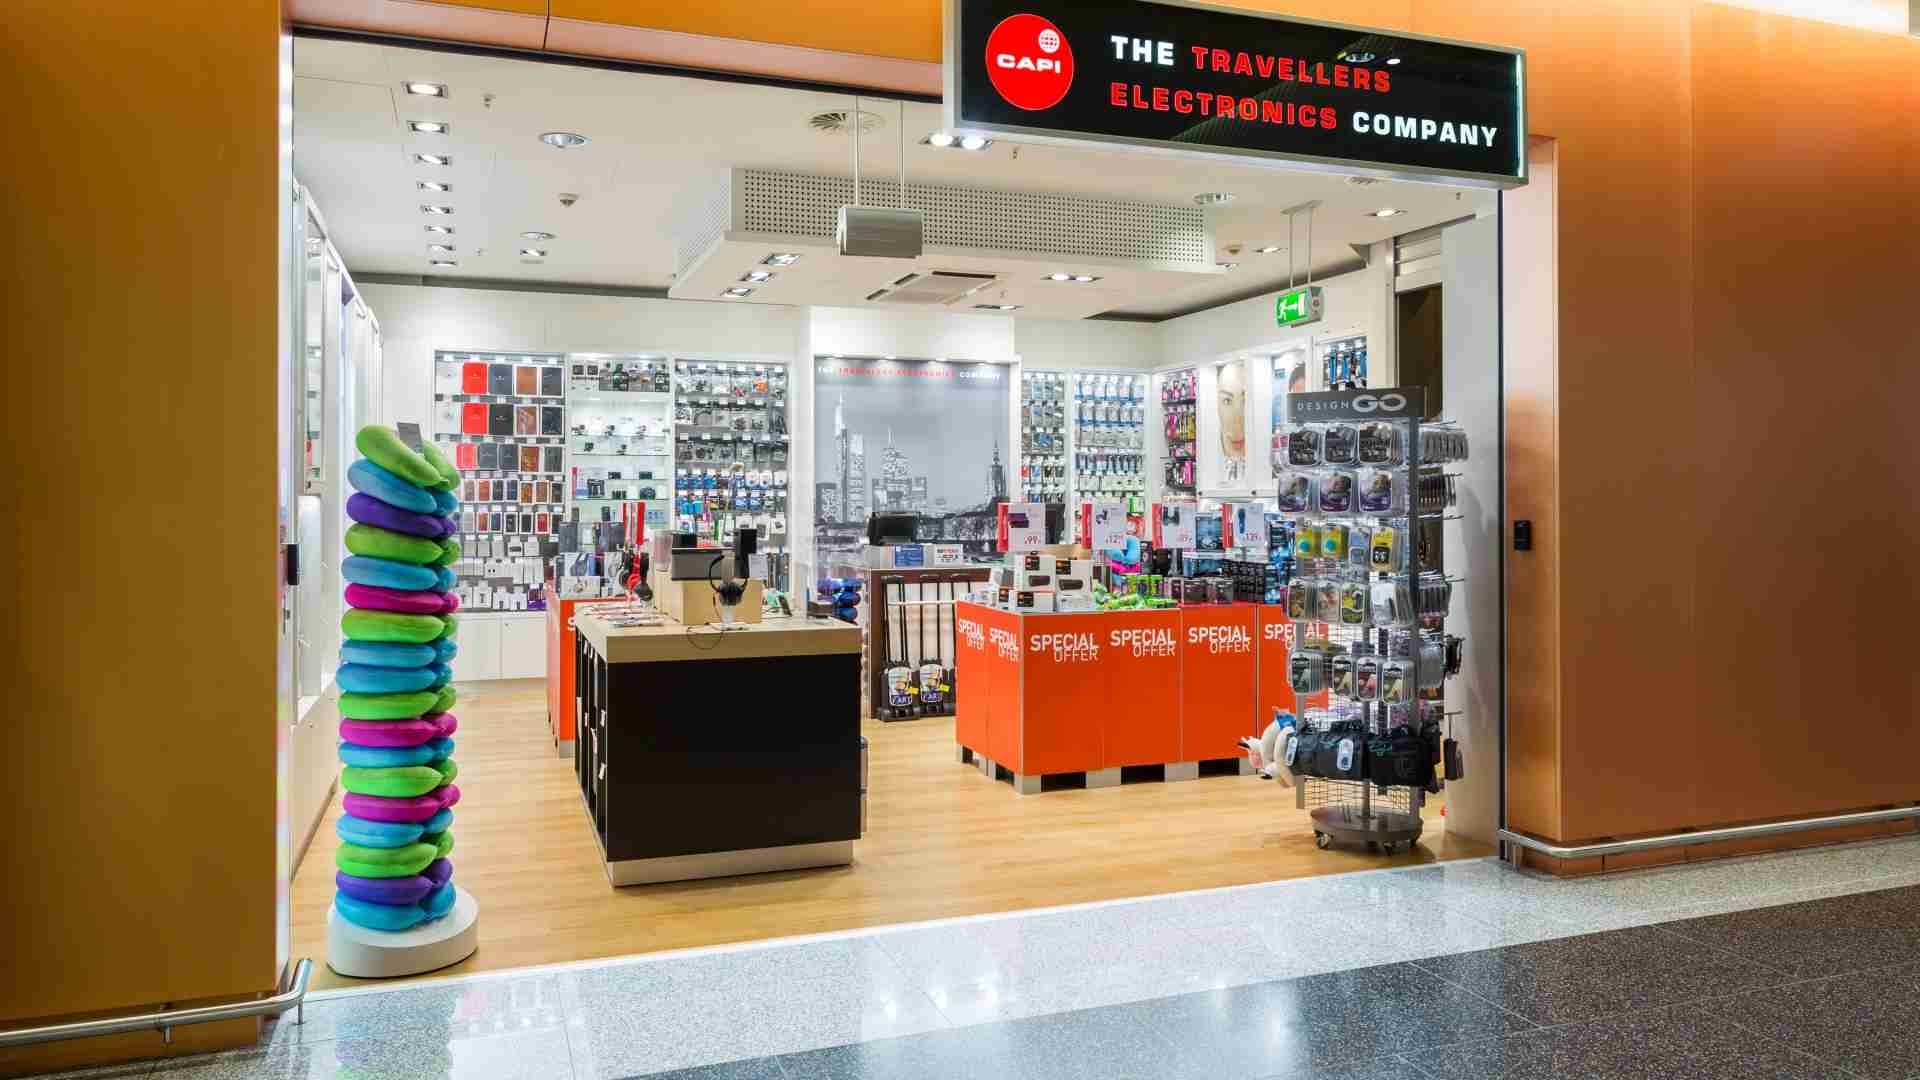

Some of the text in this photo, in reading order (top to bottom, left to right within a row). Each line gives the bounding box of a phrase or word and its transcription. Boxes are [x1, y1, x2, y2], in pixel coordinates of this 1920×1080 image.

[996, 53, 1062, 74] CAPI
[1110, 35, 1391, 93] THE TRAVELLERS
[1110, 82, 1497, 147] ELECTRONICS COMPANY
[1297, 393, 1407, 412] DESIGN GO
[959, 618, 985, 640] SPECIAL
[1110, 629, 1176, 646] SPECIAL
[1188, 626, 1251, 643] SPECIAL
[1264, 622, 1325, 640] SPEAL
[990, 627, 1018, 651] SPECIAL
[1030, 633, 1099, 651] SPECIAL
[1209, 640, 1250, 653] OFFER
[1053, 645, 1099, 662] OFFER
[1133, 642, 1176, 656] OFFER
